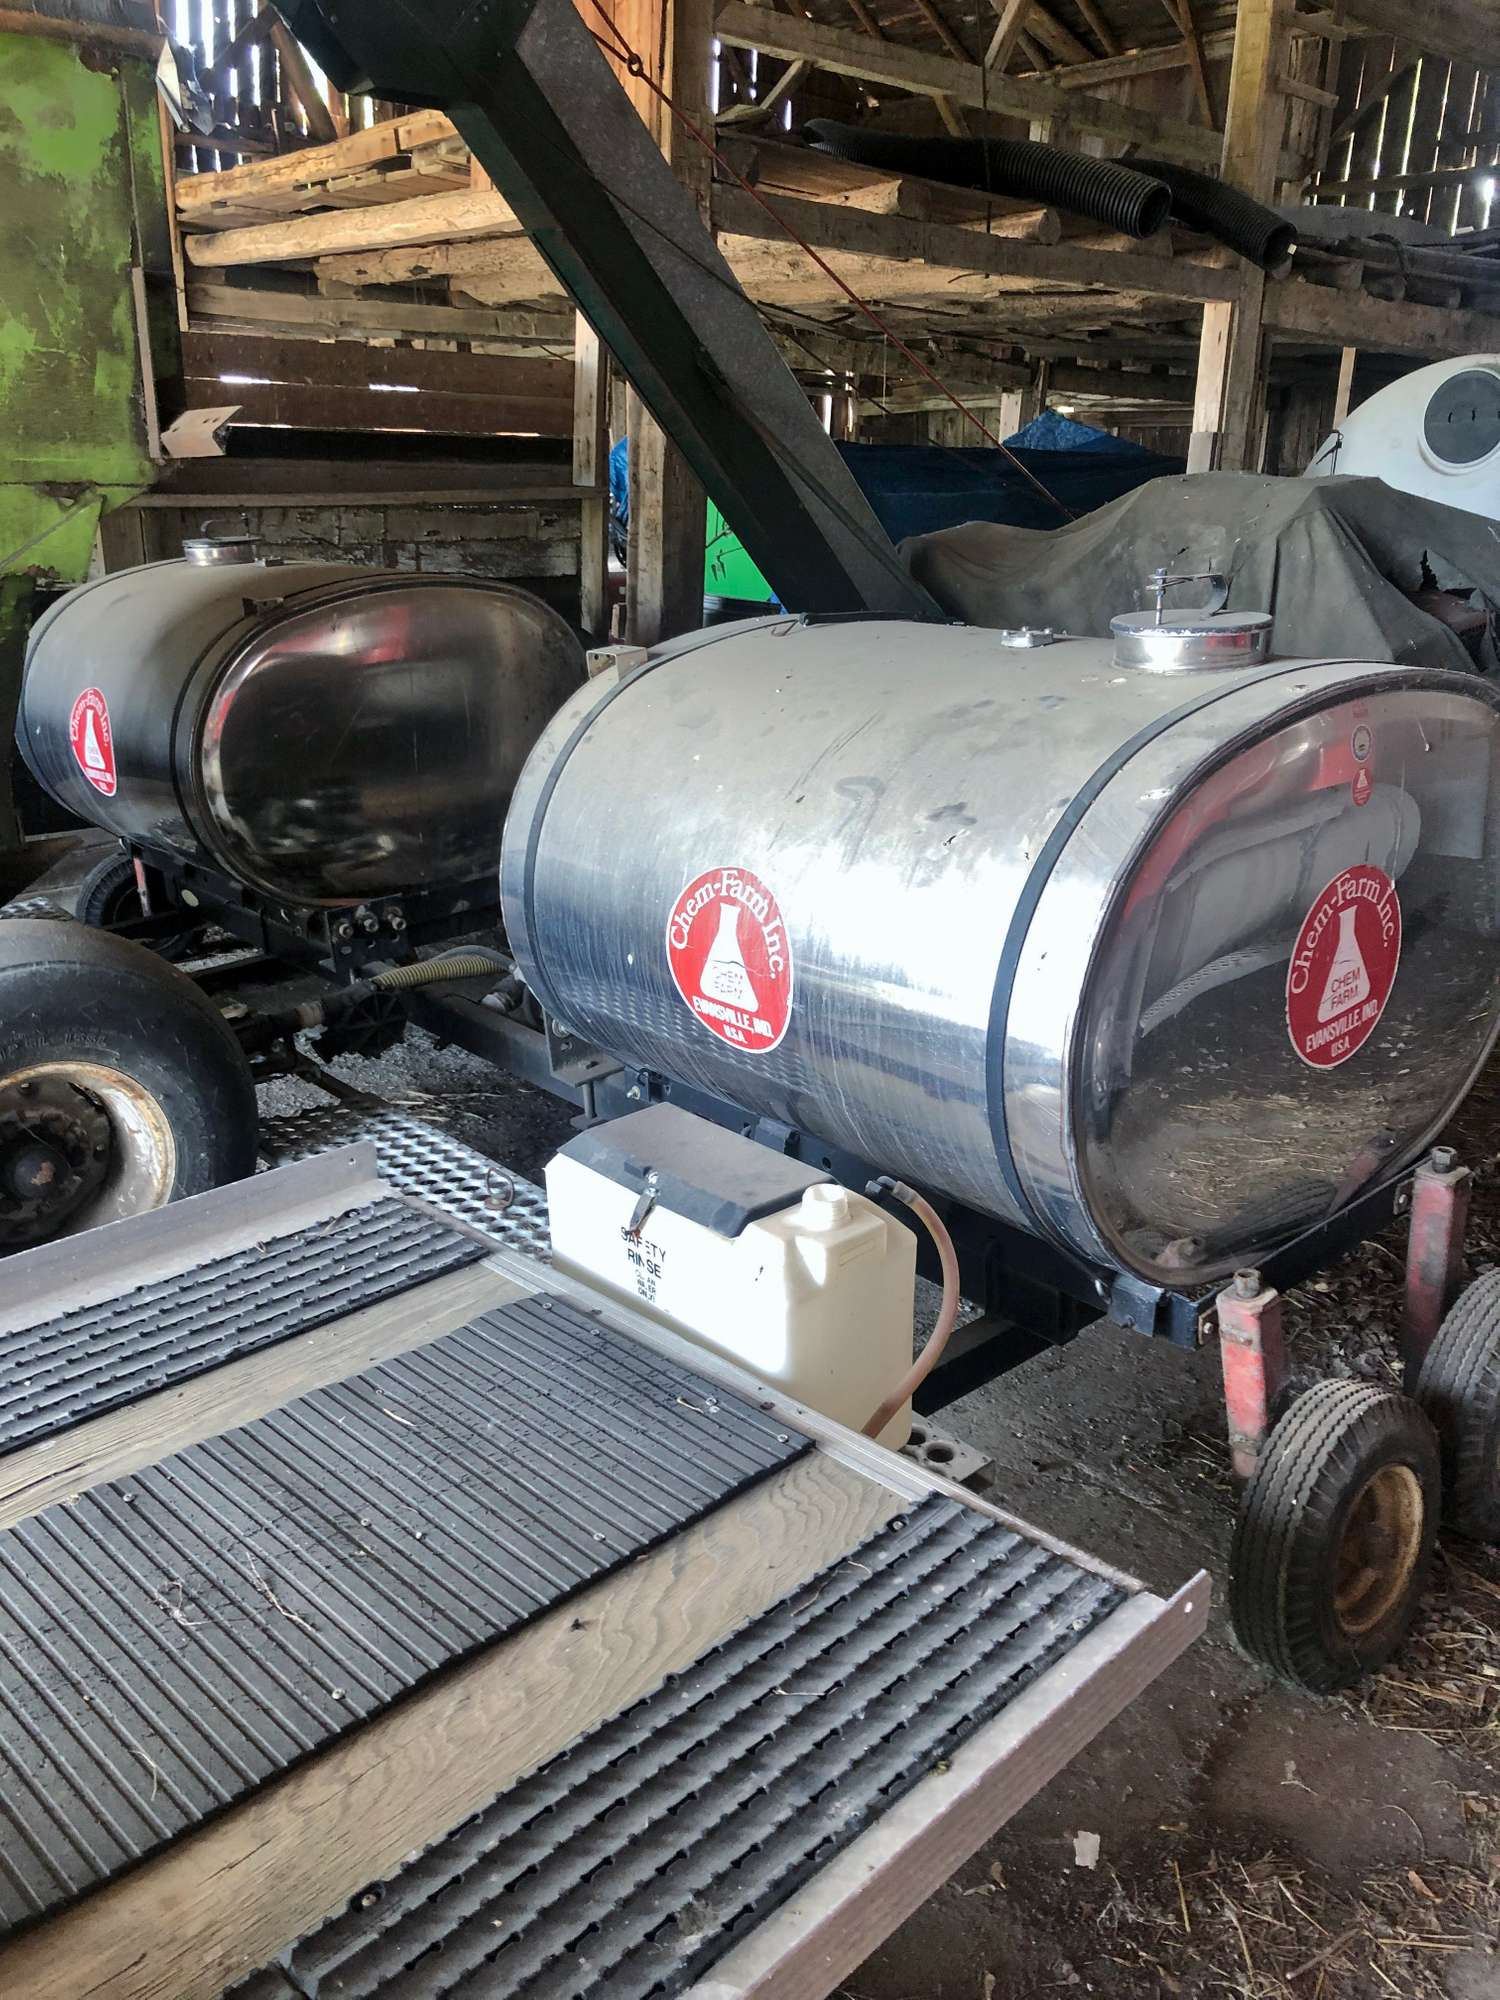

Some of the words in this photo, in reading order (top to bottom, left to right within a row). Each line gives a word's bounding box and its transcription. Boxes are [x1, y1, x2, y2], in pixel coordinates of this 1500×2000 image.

[670, 869, 770, 950] Chem-Farm
[762, 915, 784, 980] Inc.
[1290, 872, 1380, 994] Chem-Farm
[1377, 886, 1396, 948] Inc.
[1331, 966, 1361, 993] CHEM
[723, 1023, 748, 1044] USA
[1331, 1036, 1350, 1058] USA
[620, 1226, 666, 1262] SAFETY
[627, 1247, 662, 1279] RINSE
